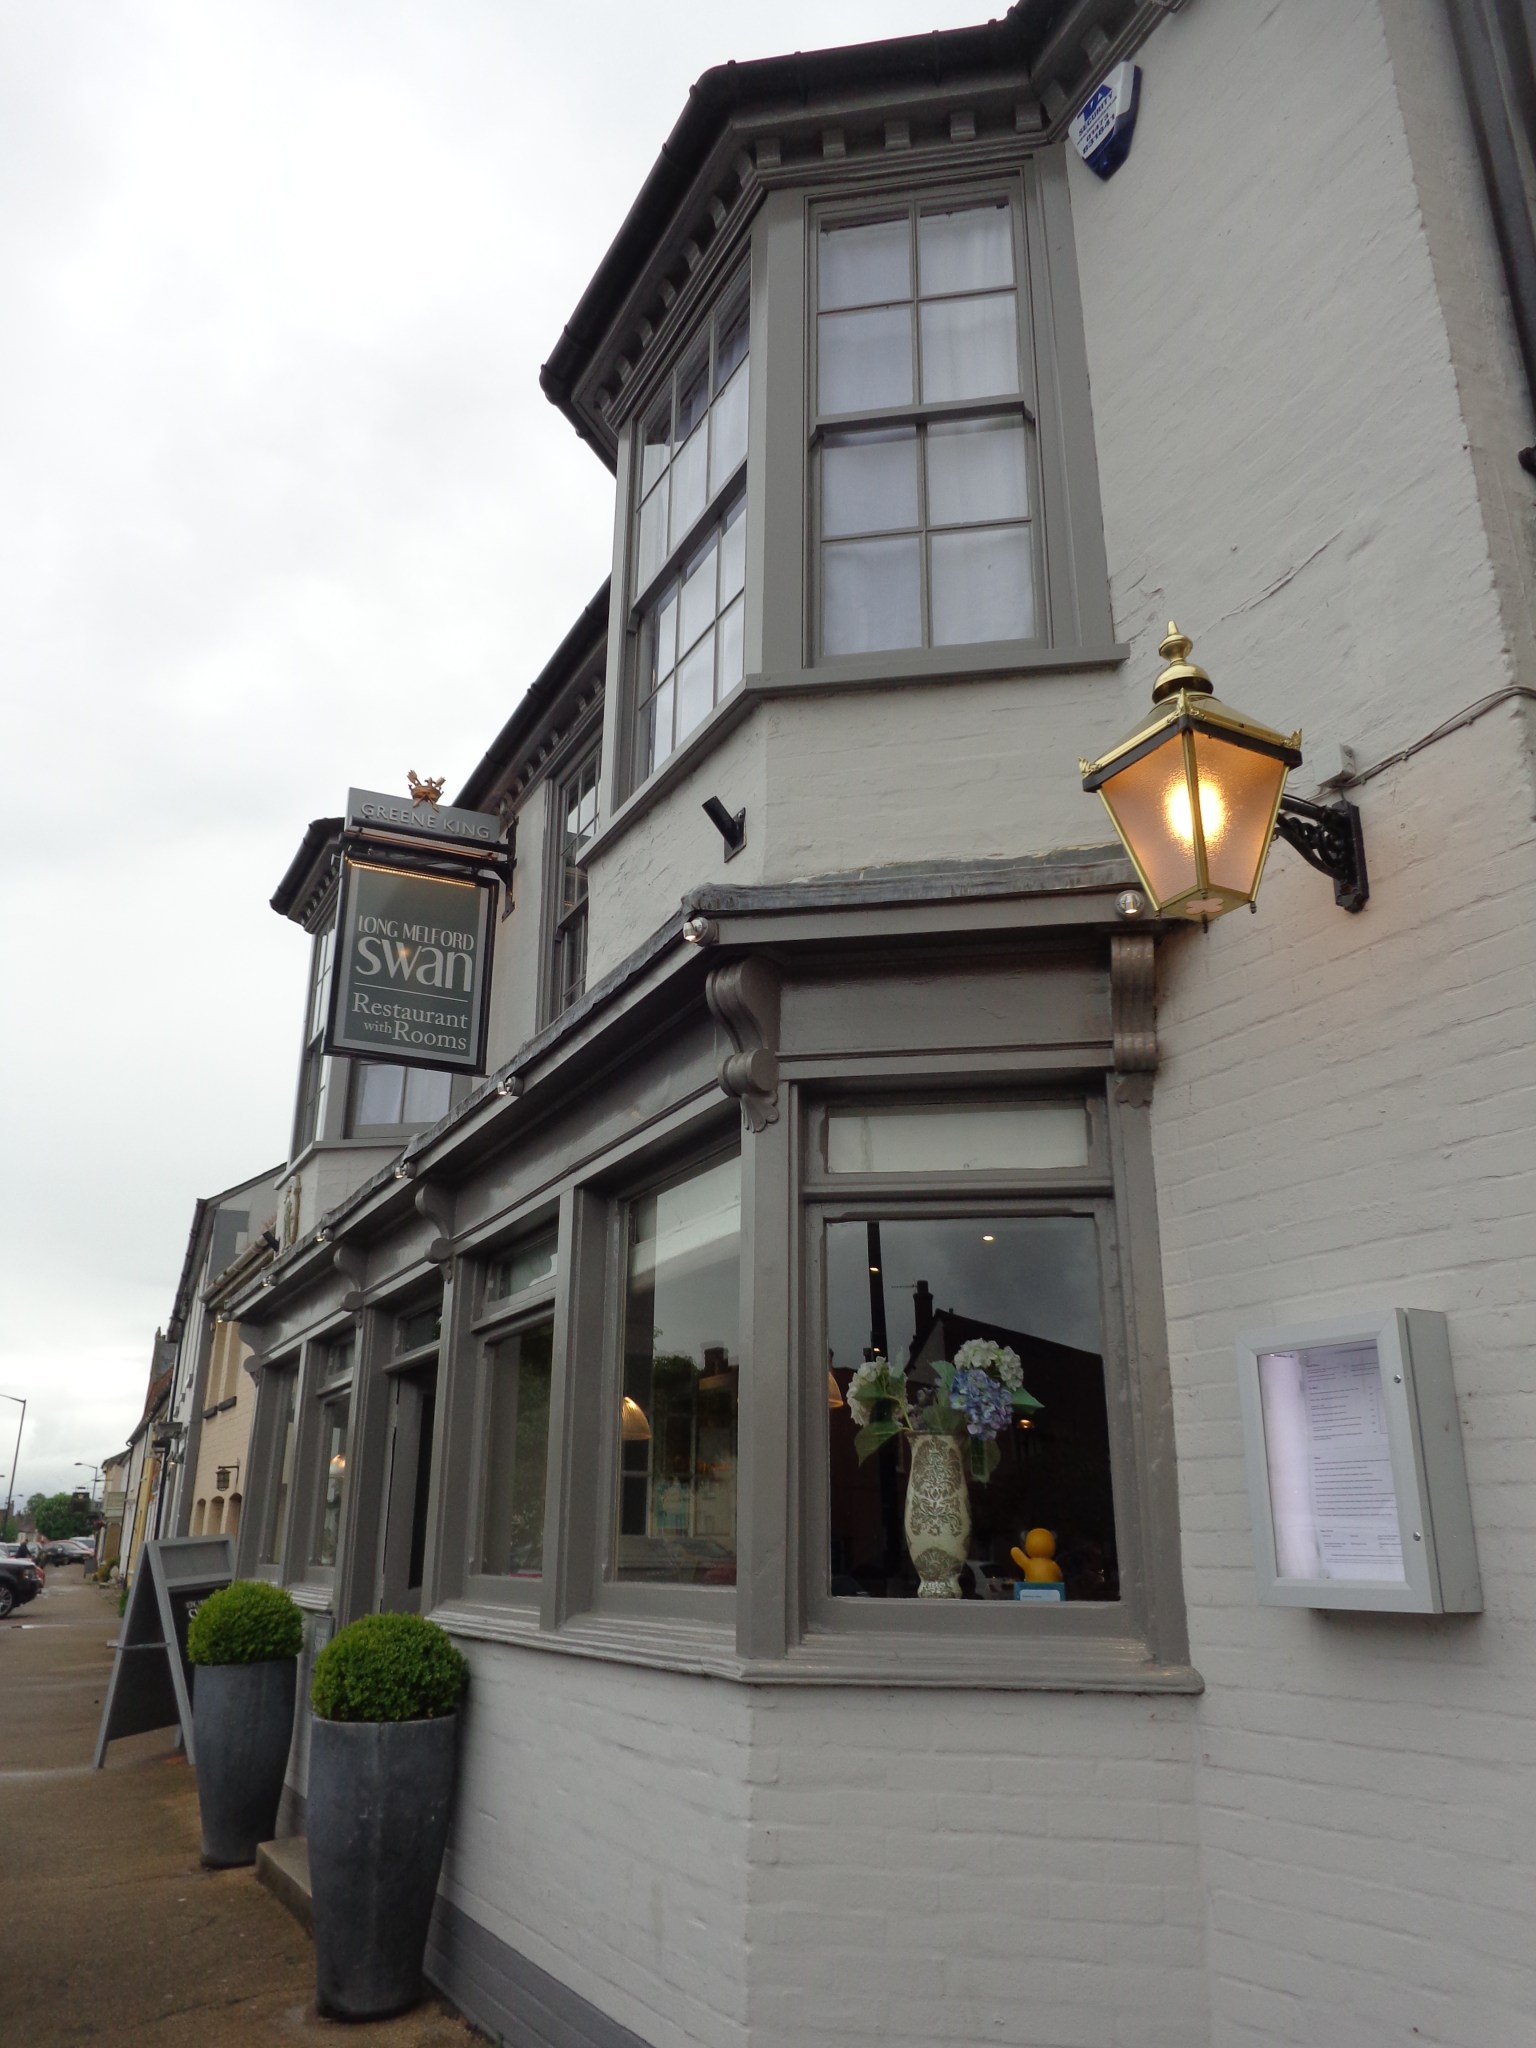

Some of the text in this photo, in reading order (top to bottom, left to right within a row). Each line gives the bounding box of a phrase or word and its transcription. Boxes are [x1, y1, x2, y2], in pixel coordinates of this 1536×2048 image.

[1078, 90, 1112, 137] SECURITY
[1086, 112, 1109, 142] 01473
[361, 803, 490, 839] GREENE KING
[358, 914, 475, 951] LONG MELFORD
[351, 991, 469, 1029] Restaurant
[363, 1020, 467, 1050] with Rooms
